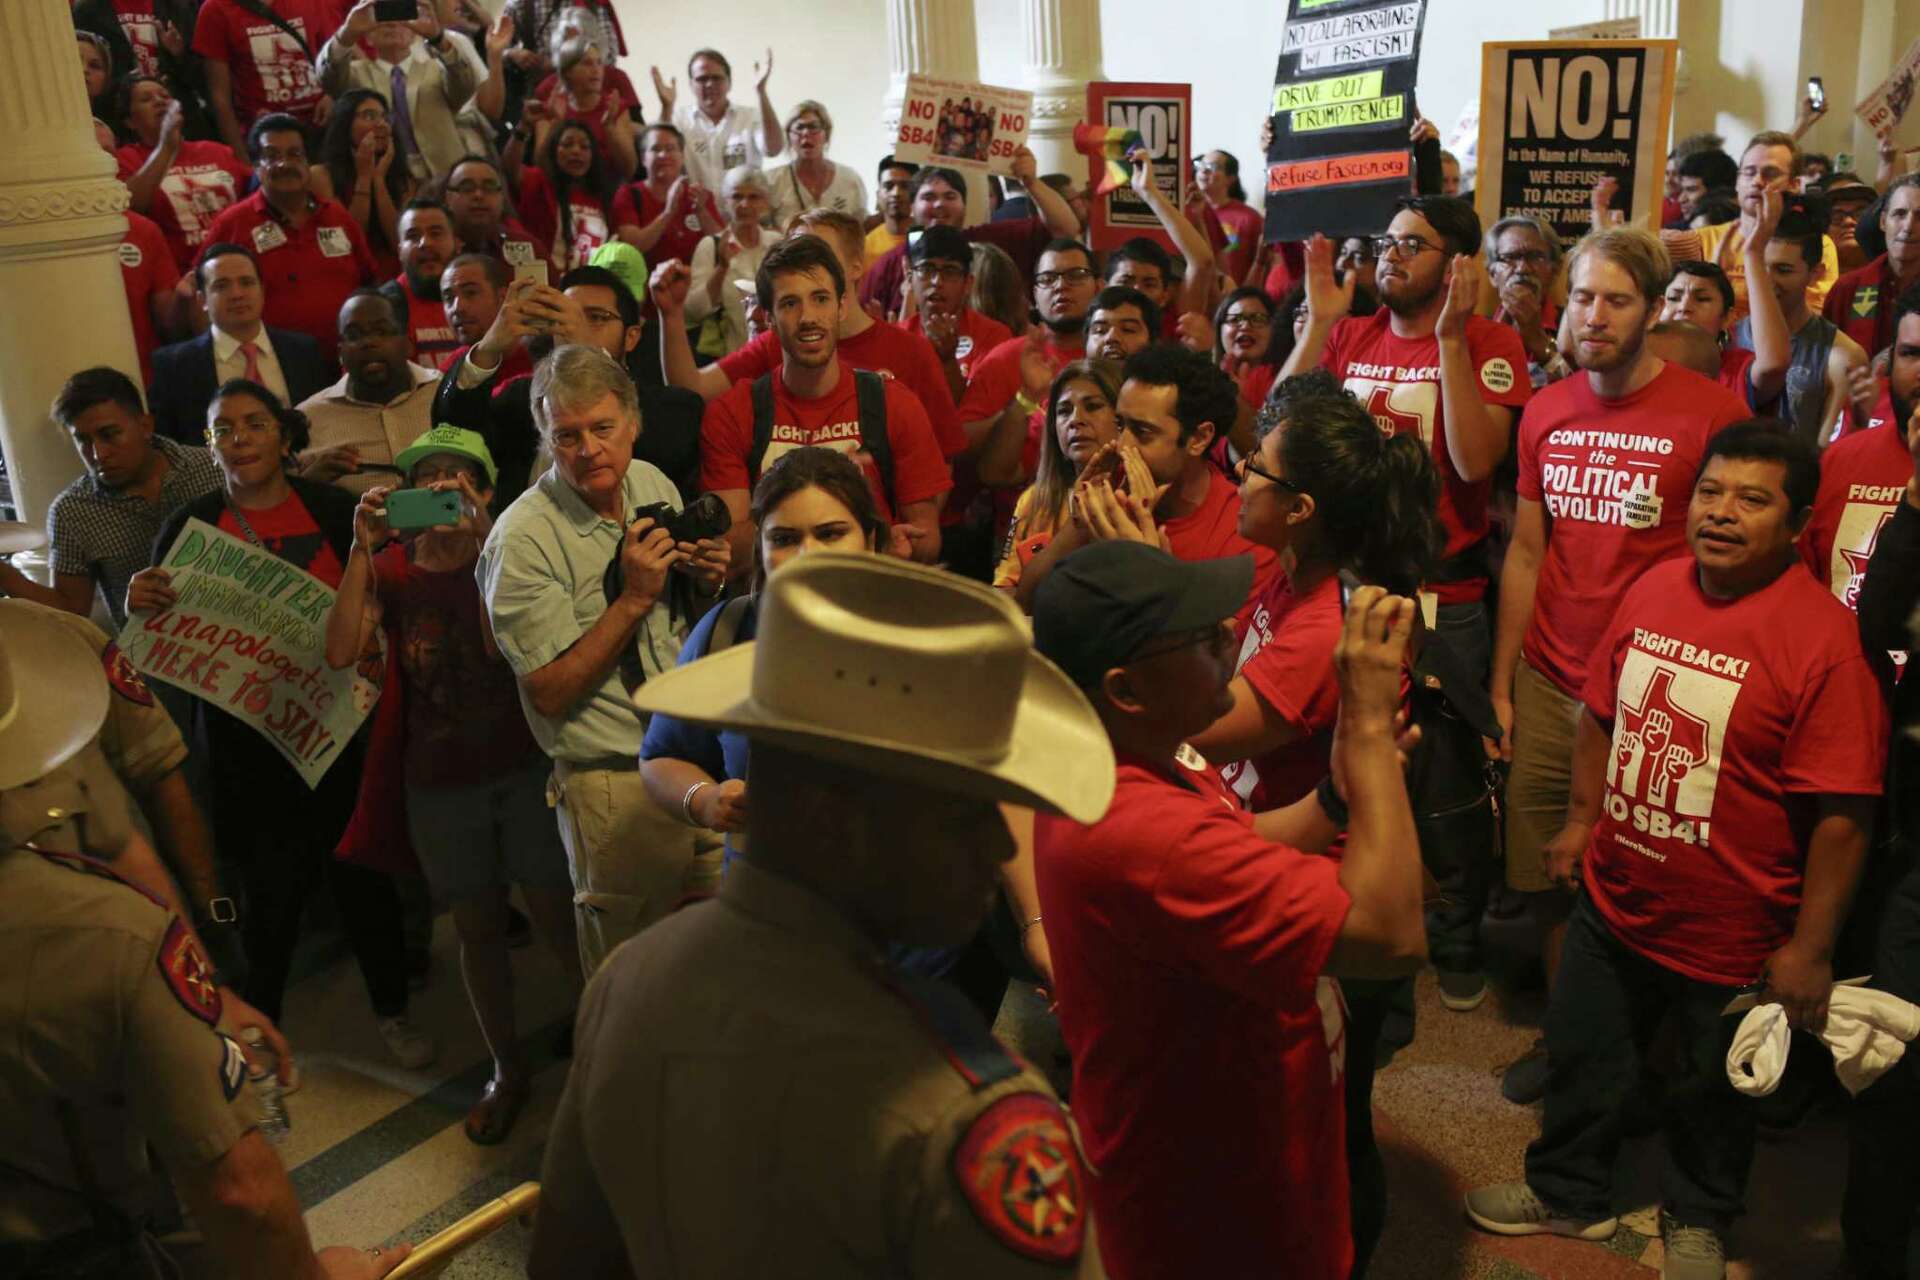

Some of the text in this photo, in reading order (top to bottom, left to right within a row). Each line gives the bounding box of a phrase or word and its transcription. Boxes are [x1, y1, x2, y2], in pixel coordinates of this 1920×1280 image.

[1333, 32, 1410, 64] FASCISM!
[1332, 76, 1366, 98] OUT
[1510, 55, 1638, 141] NO!
[909, 98, 936, 121] NO
[1294, 96, 1401, 128] TRUMP/PENCE!
[1000, 112, 1026, 133] NO
[899, 124, 935, 146] SB4
[1508, 149, 1631, 168] In the Name of Humanity,
[1529, 170, 1552, 185] WE
[1523, 188, 1541, 203] TO
[1347, 362, 1394, 380] FIGHT
[812, 421, 860, 442] BACK!
[1548, 430, 1674, 455] CONTINUING
[1588, 449, 1617, 466] the
[1635, 493, 1651, 502] STOP
[1848, 484, 1907, 502] FIGHT
[1624, 500, 1659, 514] SEPARATING
[170, 529, 338, 625] DAUGHTER
[1633, 626, 1751, 680] FIGHT BACK!
[142, 635, 231, 694] HERE
[263, 699, 336, 768] STAY!
[1632, 804, 1711, 848] SB4!
